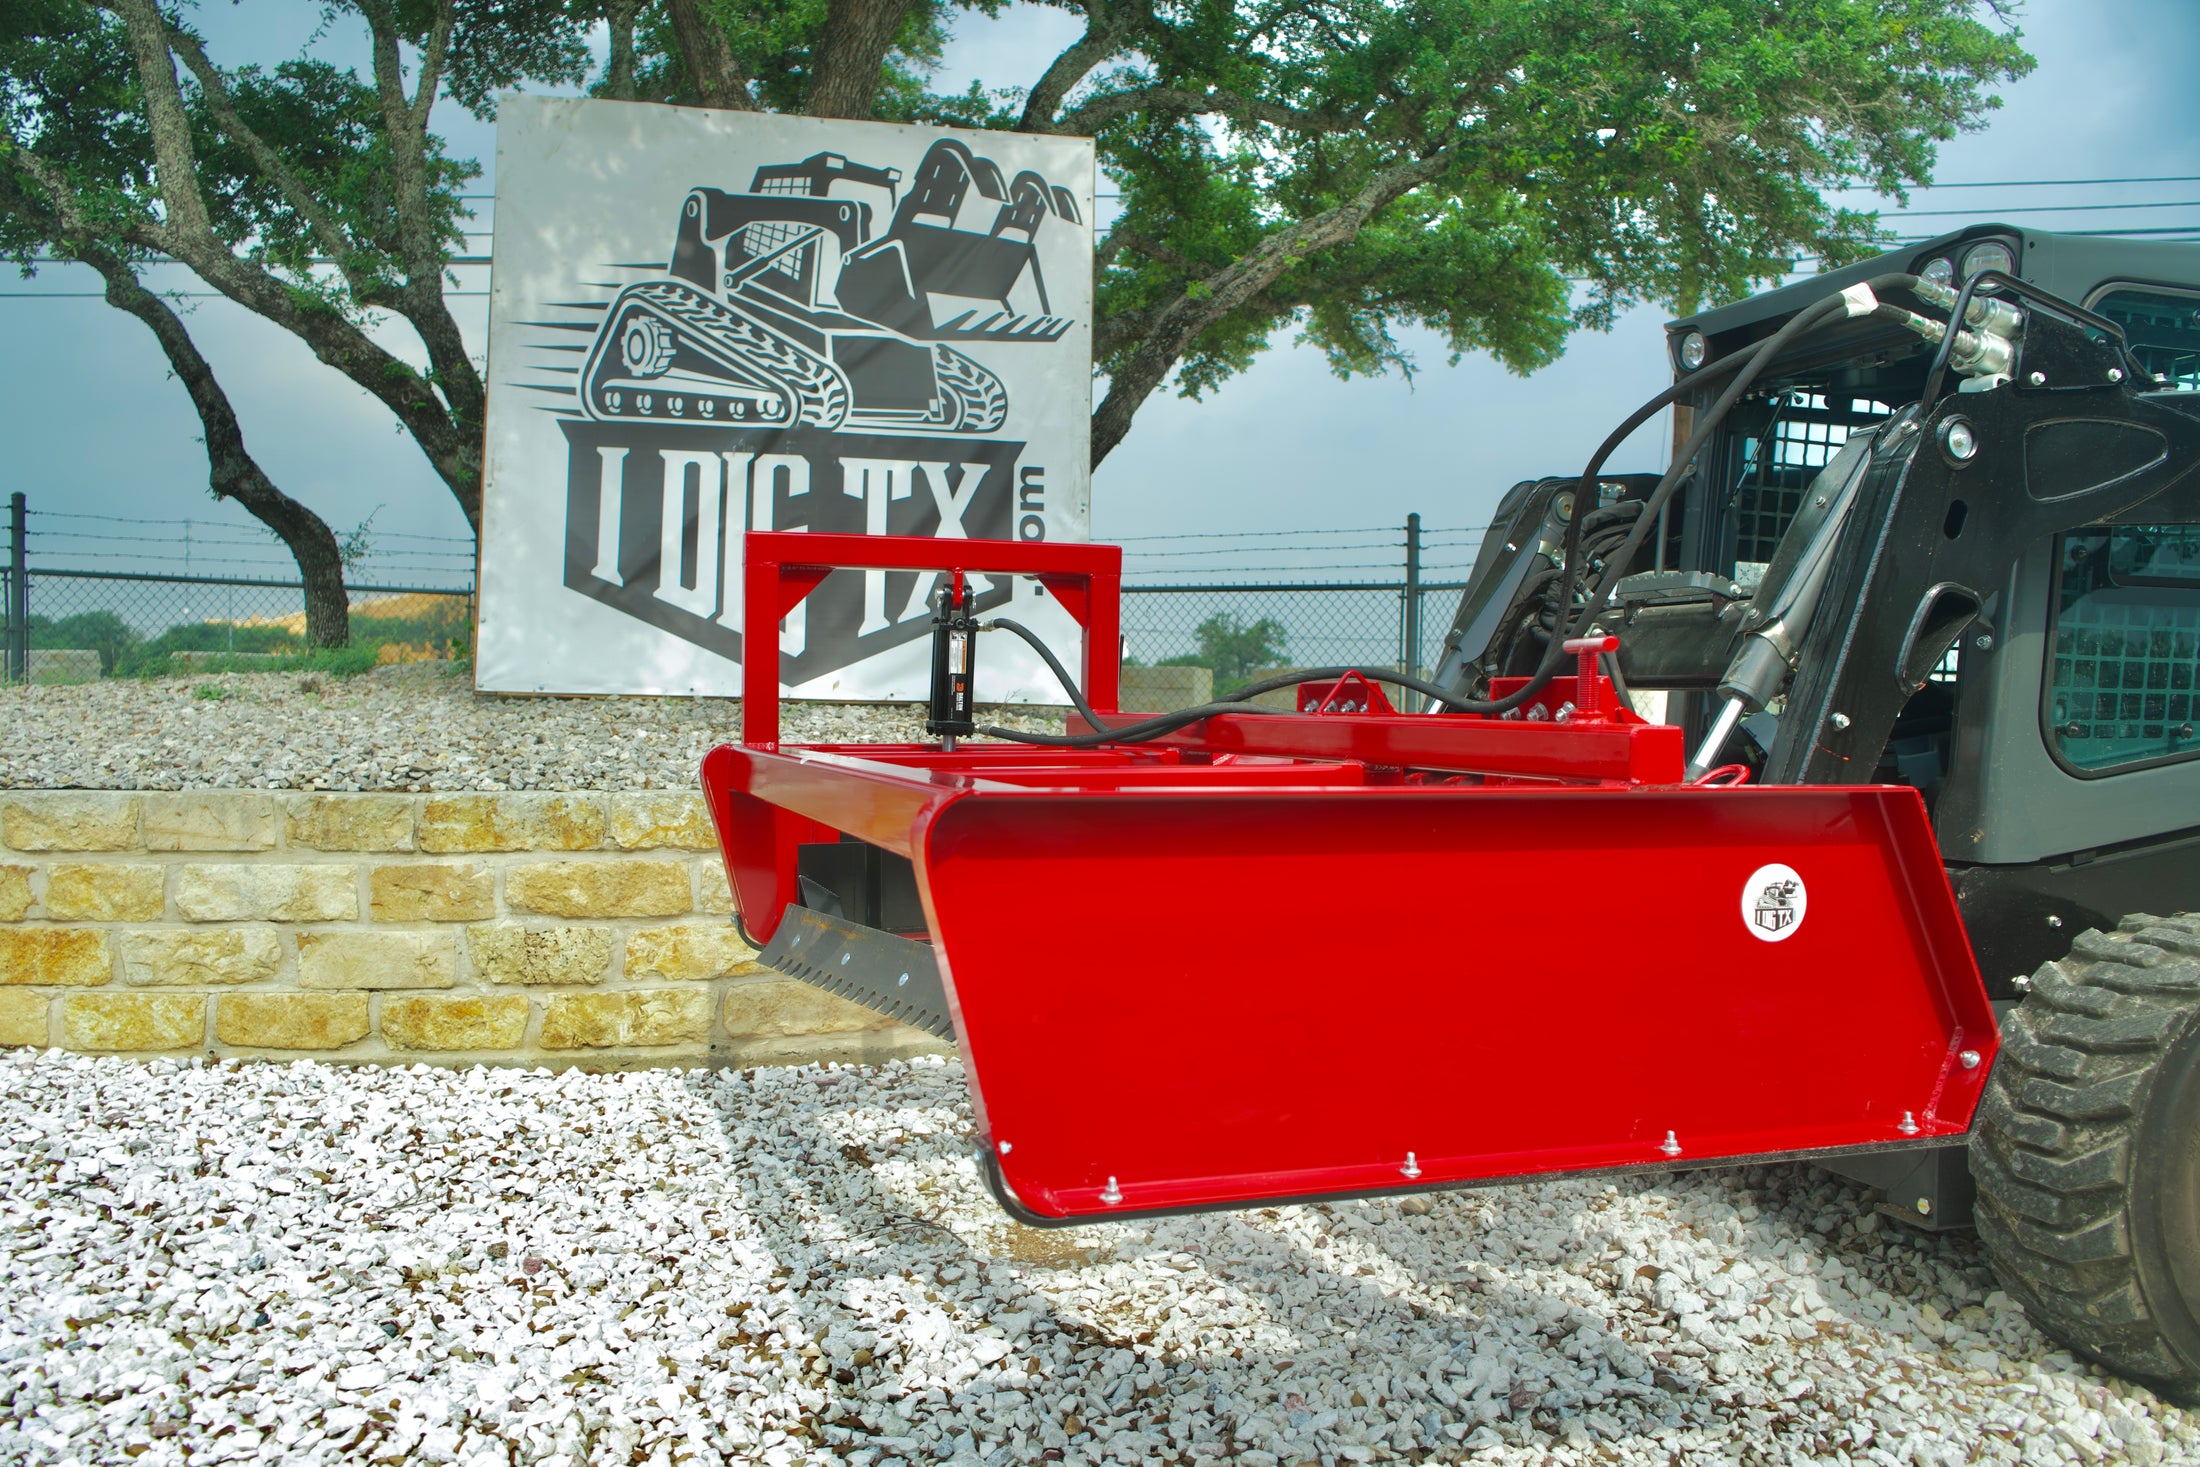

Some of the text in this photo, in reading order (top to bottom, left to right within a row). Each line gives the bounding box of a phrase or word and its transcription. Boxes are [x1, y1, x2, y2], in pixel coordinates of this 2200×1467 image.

[590, 446, 630, 588] I
[838, 457, 995, 638] TX
[1019, 466, 1046, 596] .om
[1777, 910, 1792, 928] TX
